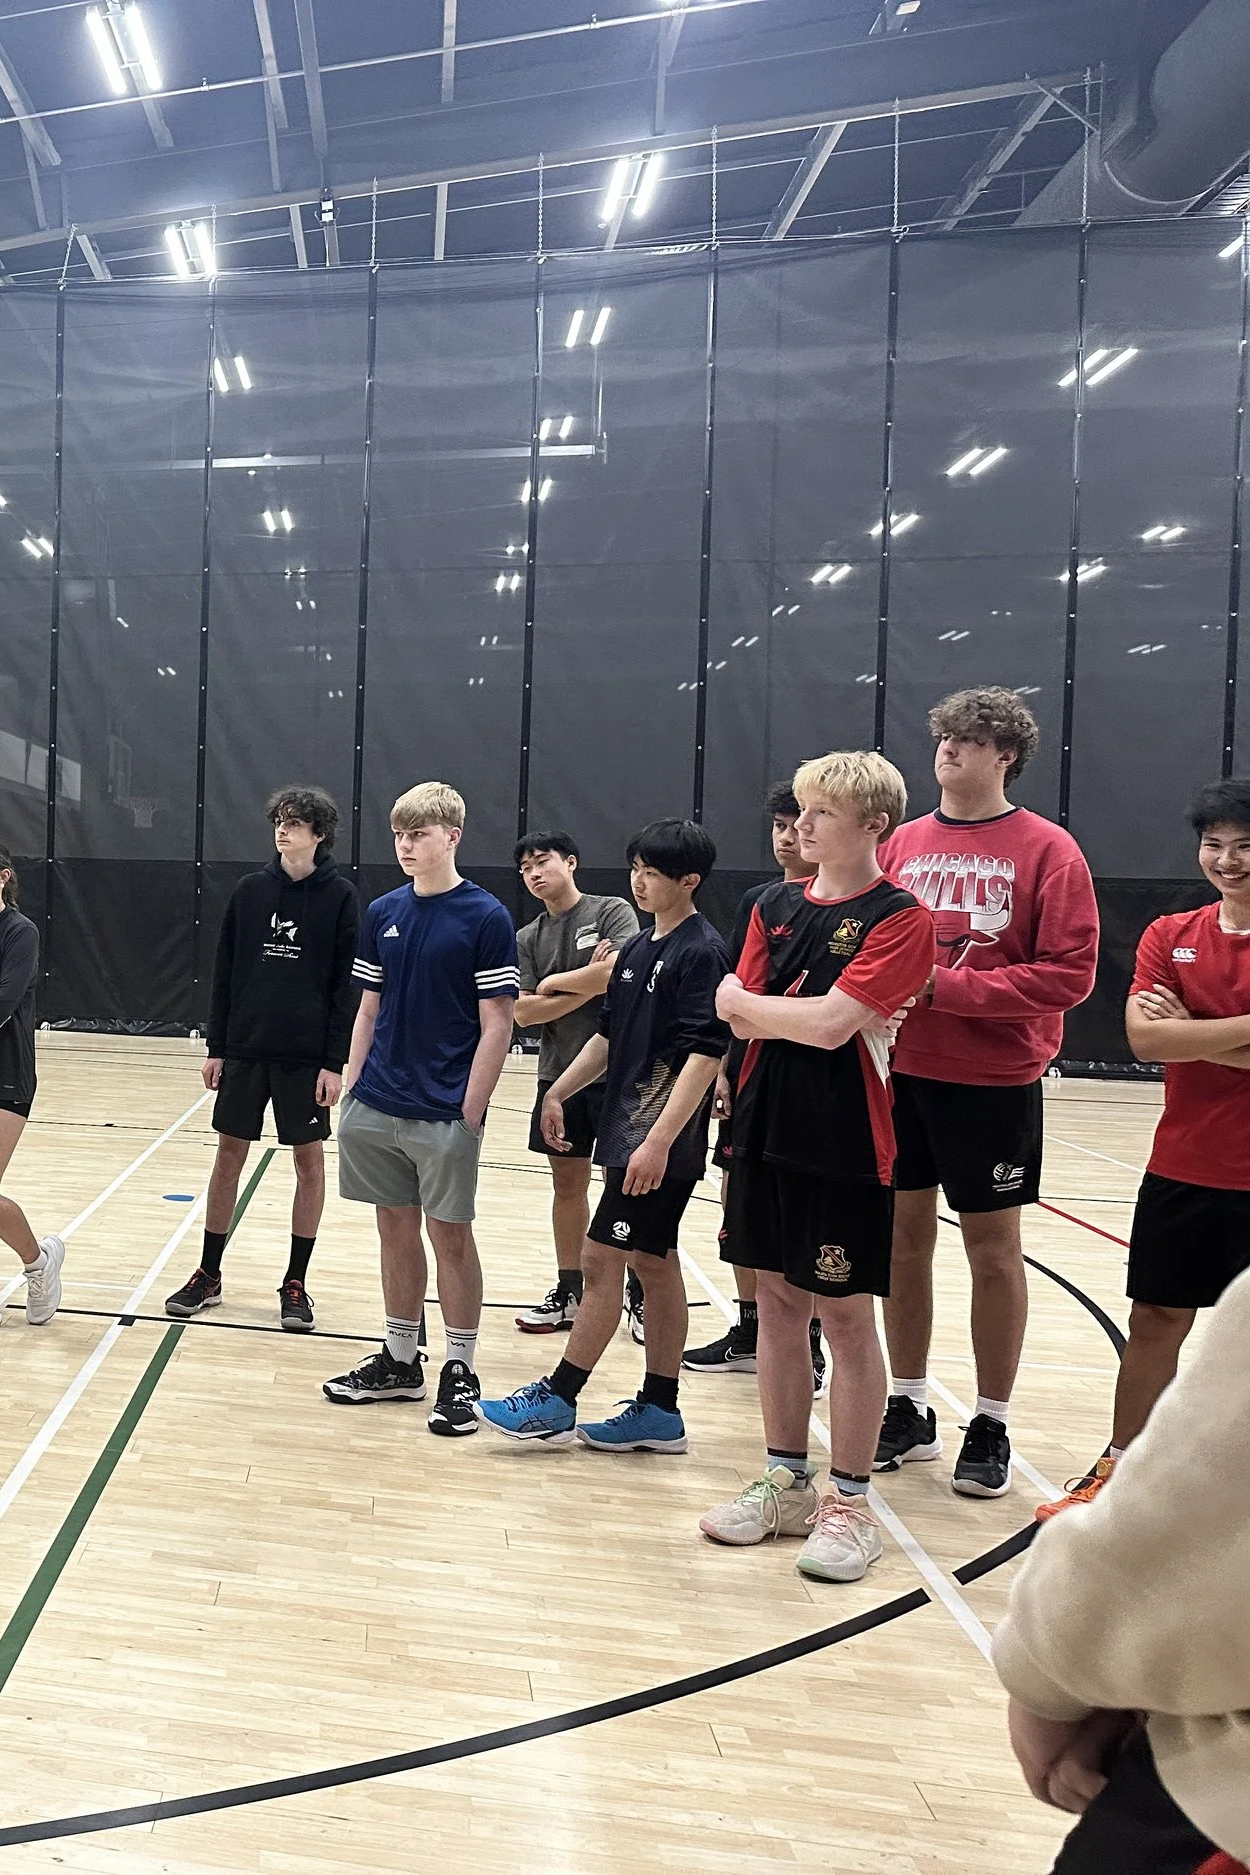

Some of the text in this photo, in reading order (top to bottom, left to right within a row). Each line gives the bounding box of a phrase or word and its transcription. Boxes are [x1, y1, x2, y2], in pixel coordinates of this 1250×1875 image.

[900, 852, 1015, 882] CHICAGO
[900, 870, 1012, 915] ULLS
[388, 1329, 413, 1339] RVCA
